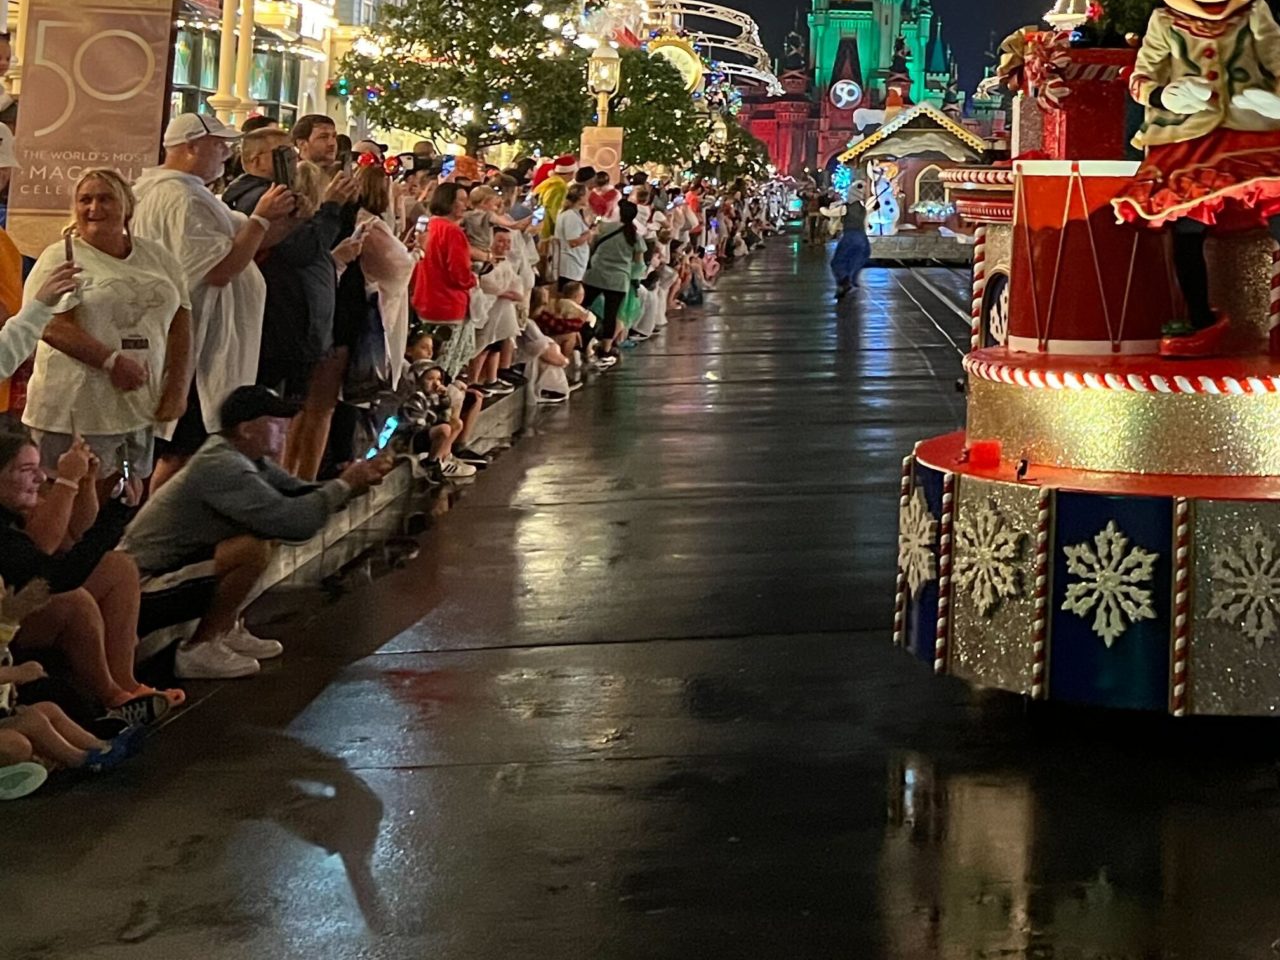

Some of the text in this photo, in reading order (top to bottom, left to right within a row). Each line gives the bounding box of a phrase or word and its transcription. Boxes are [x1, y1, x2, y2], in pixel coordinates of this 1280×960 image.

[34, 19, 156, 138] 50
[836, 83, 859, 108] 50
[23, 150, 149, 163] THE WORLD'S MOST
